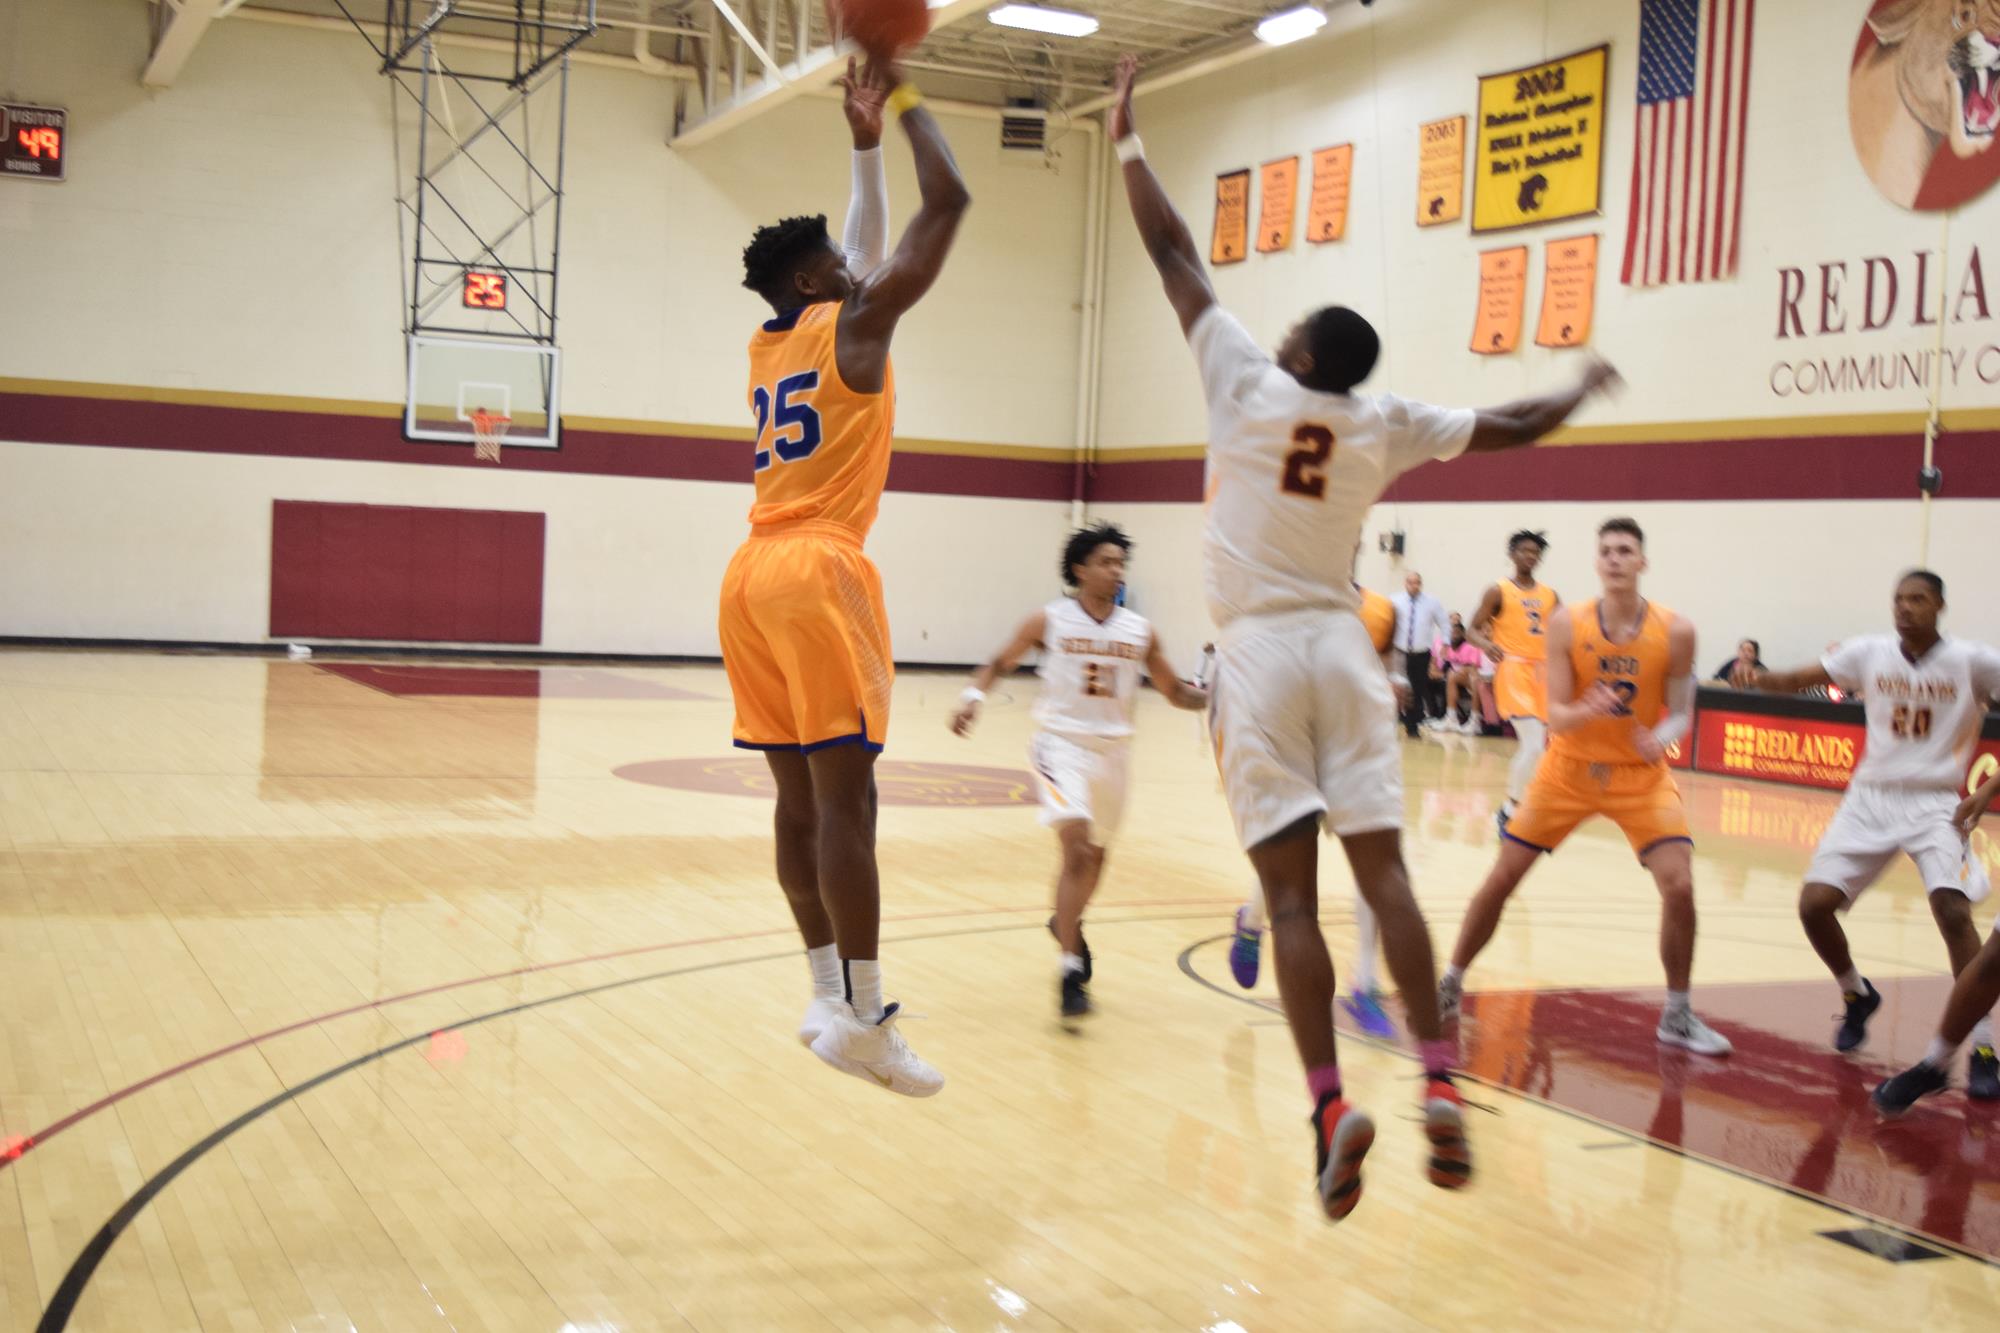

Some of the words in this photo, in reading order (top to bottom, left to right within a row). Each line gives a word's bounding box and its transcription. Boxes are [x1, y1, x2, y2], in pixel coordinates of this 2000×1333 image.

[18, 128, 60, 160] 49
[465, 272, 506, 309] 25
[1775, 243, 1993, 340] REDLA
[753, 368, 823, 472] 25
[1281, 421, 1336, 500] 2
[1755, 728, 1855, 769] REDLANDS
